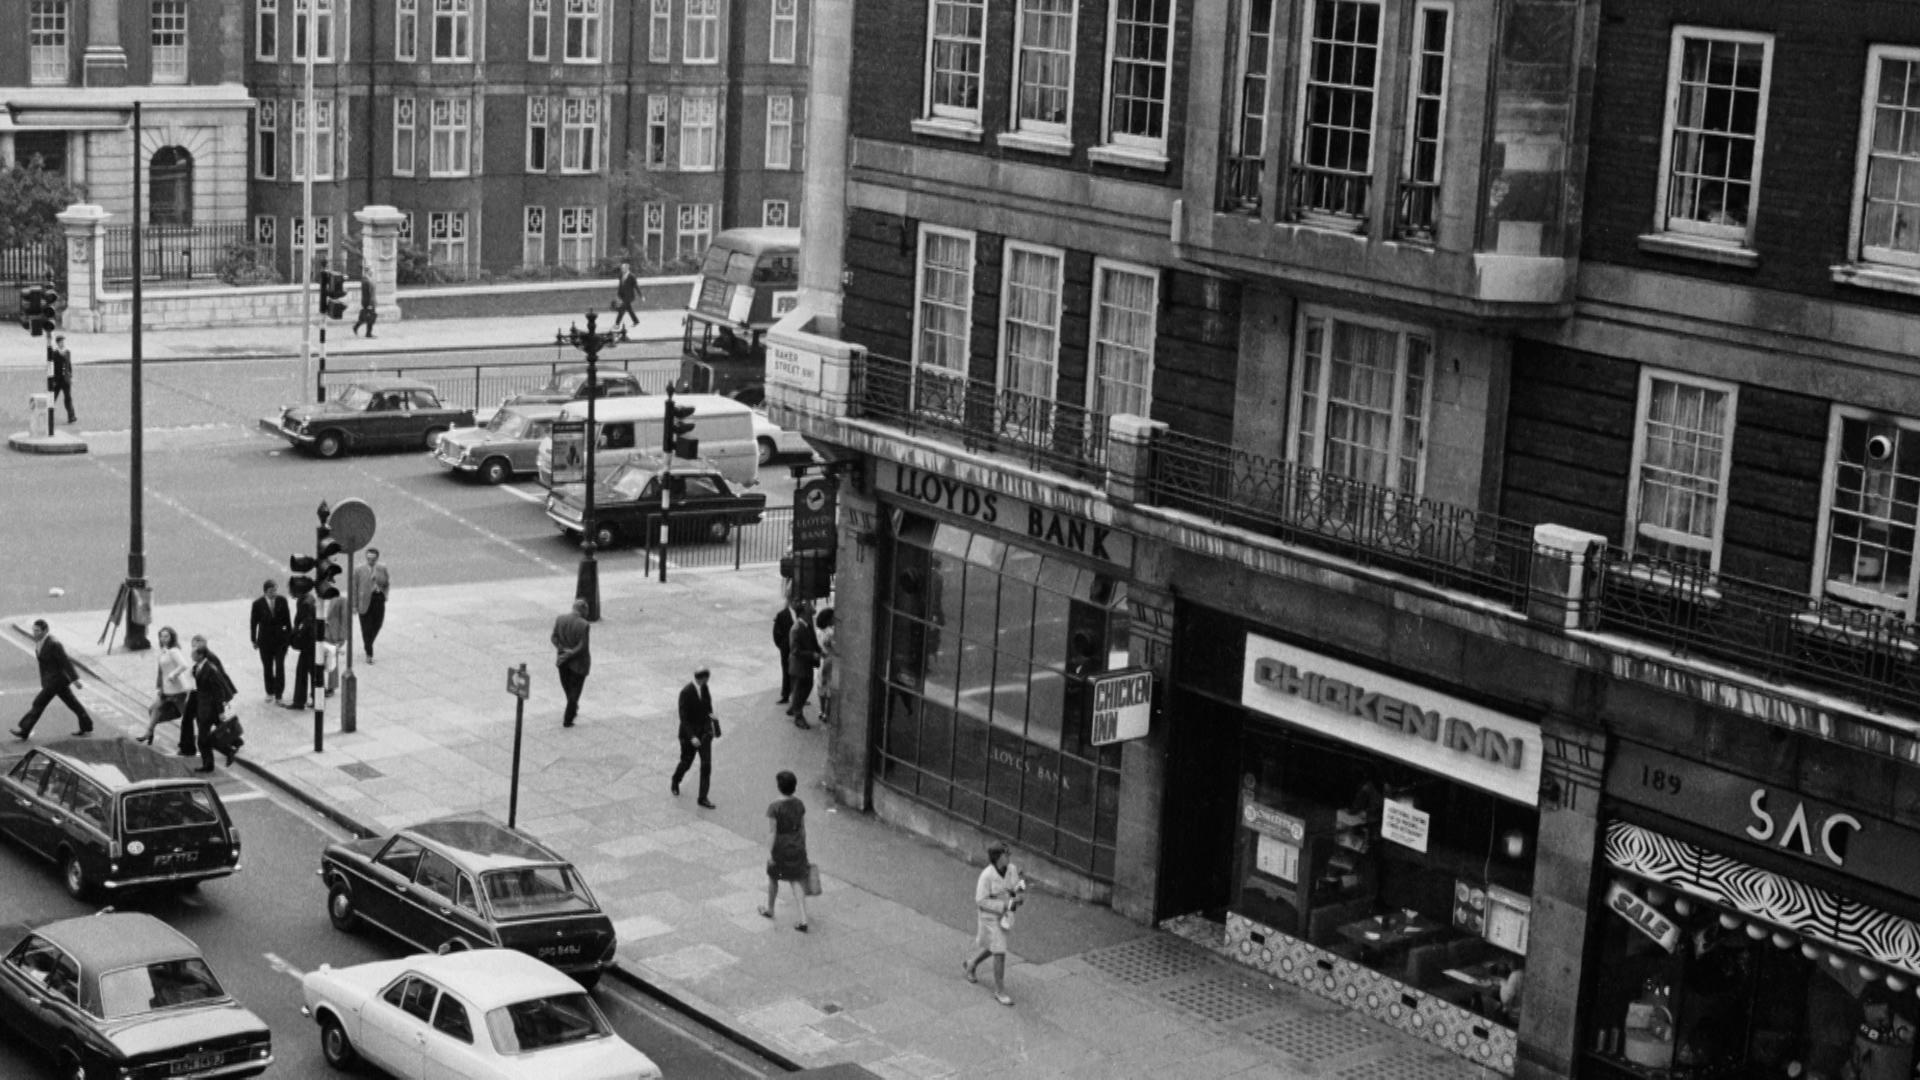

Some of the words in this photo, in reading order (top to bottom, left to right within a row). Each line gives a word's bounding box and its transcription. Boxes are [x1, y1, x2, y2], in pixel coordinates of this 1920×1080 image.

[775, 350, 798, 362] BAKER
[775, 361, 800, 376] STREET
[896, 467, 997, 523] LLOYDS
[1028, 504, 1110, 560] BANK
[1096, 676, 1151, 712] CHICKEN
[1093, 711, 1119, 743] INN
[1254, 656, 1440, 742] CHICKEN
[1443, 717, 1523, 769] INN
[1642, 766, 1681, 795] 189
[1746, 789, 1862, 866] SAC
[1613, 893, 1671, 941] SALE
